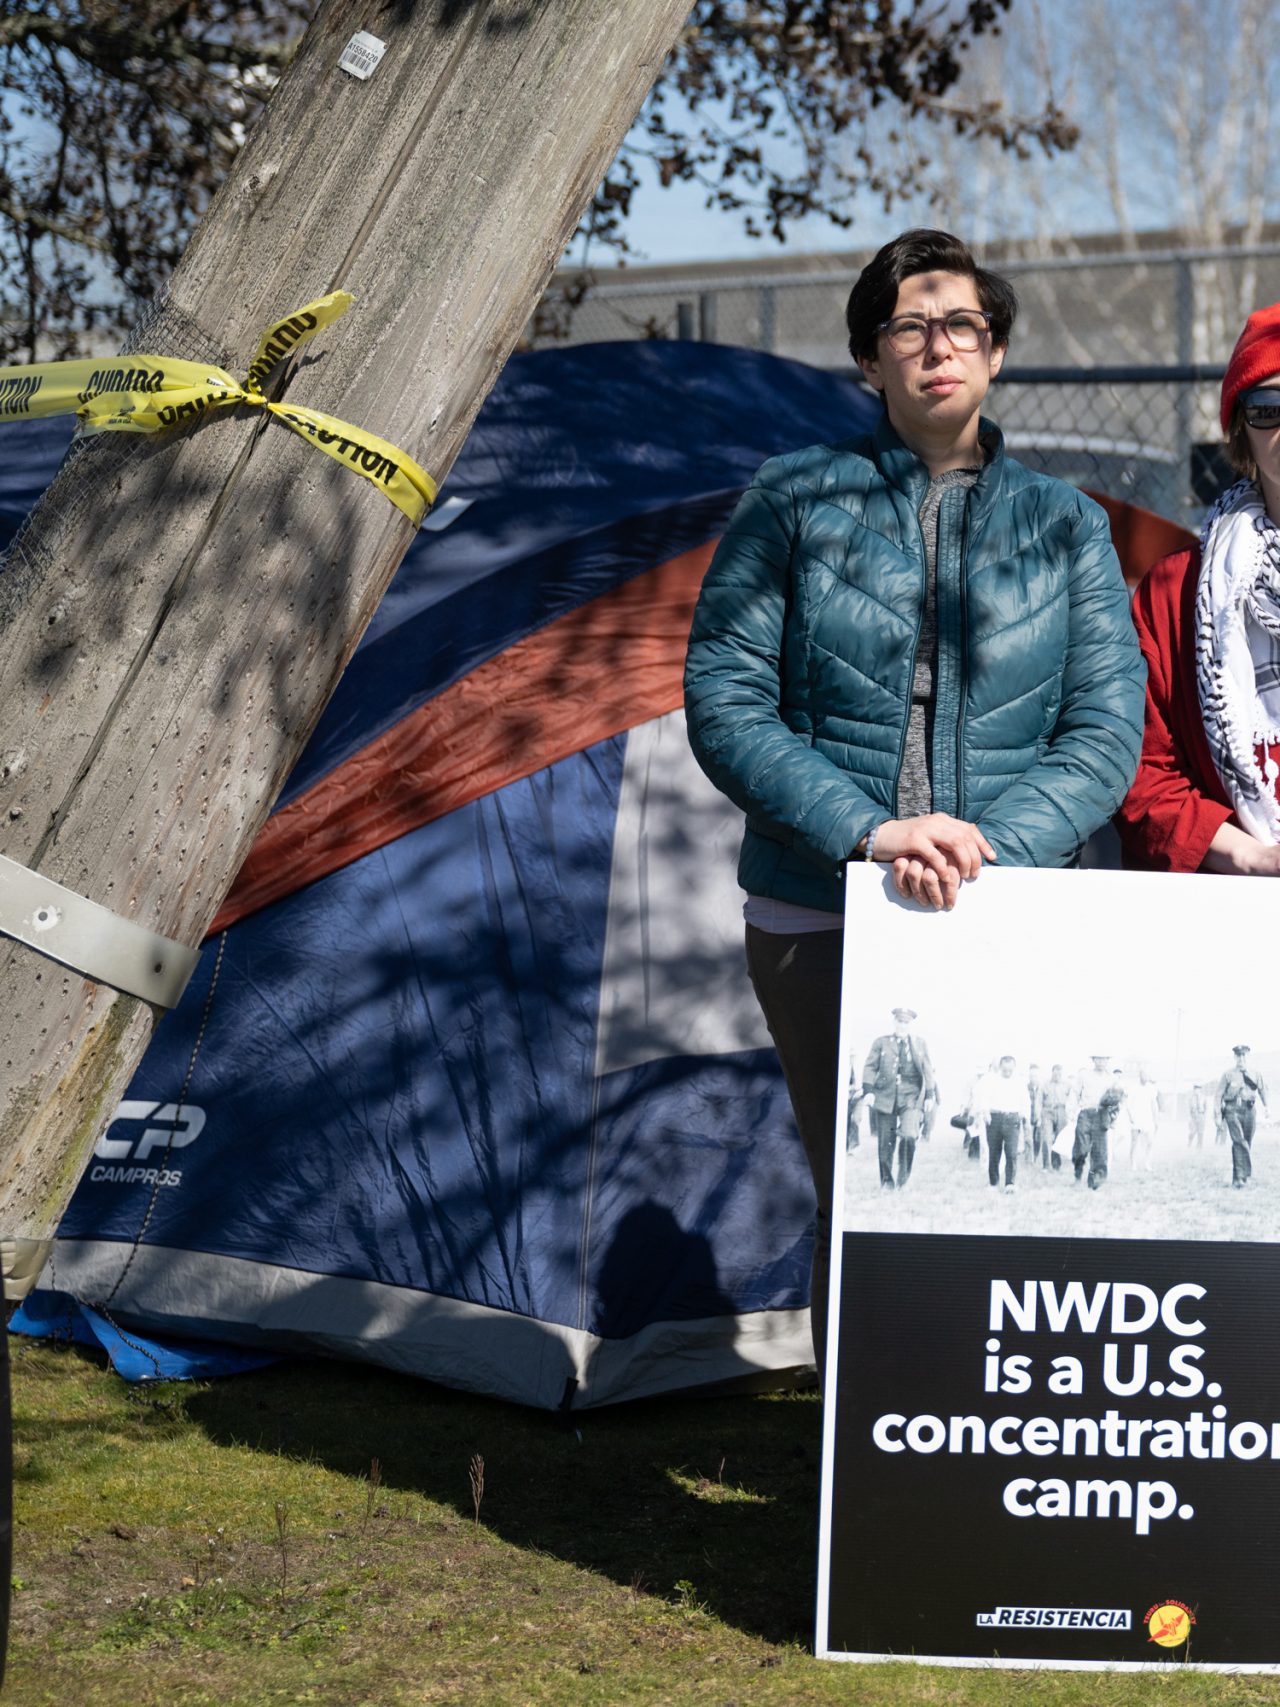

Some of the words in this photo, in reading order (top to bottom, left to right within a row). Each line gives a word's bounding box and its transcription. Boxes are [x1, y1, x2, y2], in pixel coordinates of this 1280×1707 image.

[90, 1165, 182, 1186] CAMPROS
[988, 1278, 1208, 1337] NWDC
[984, 1338, 1033, 1394] is
[1047, 1355, 1083, 1395] a
[1102, 1343, 1222, 1398] U.S.
[1001, 1476, 1195, 1535] camp.
[979, 1615, 993, 1624] LA
[1000, 1609, 1128, 1628] RESISTENCIA
